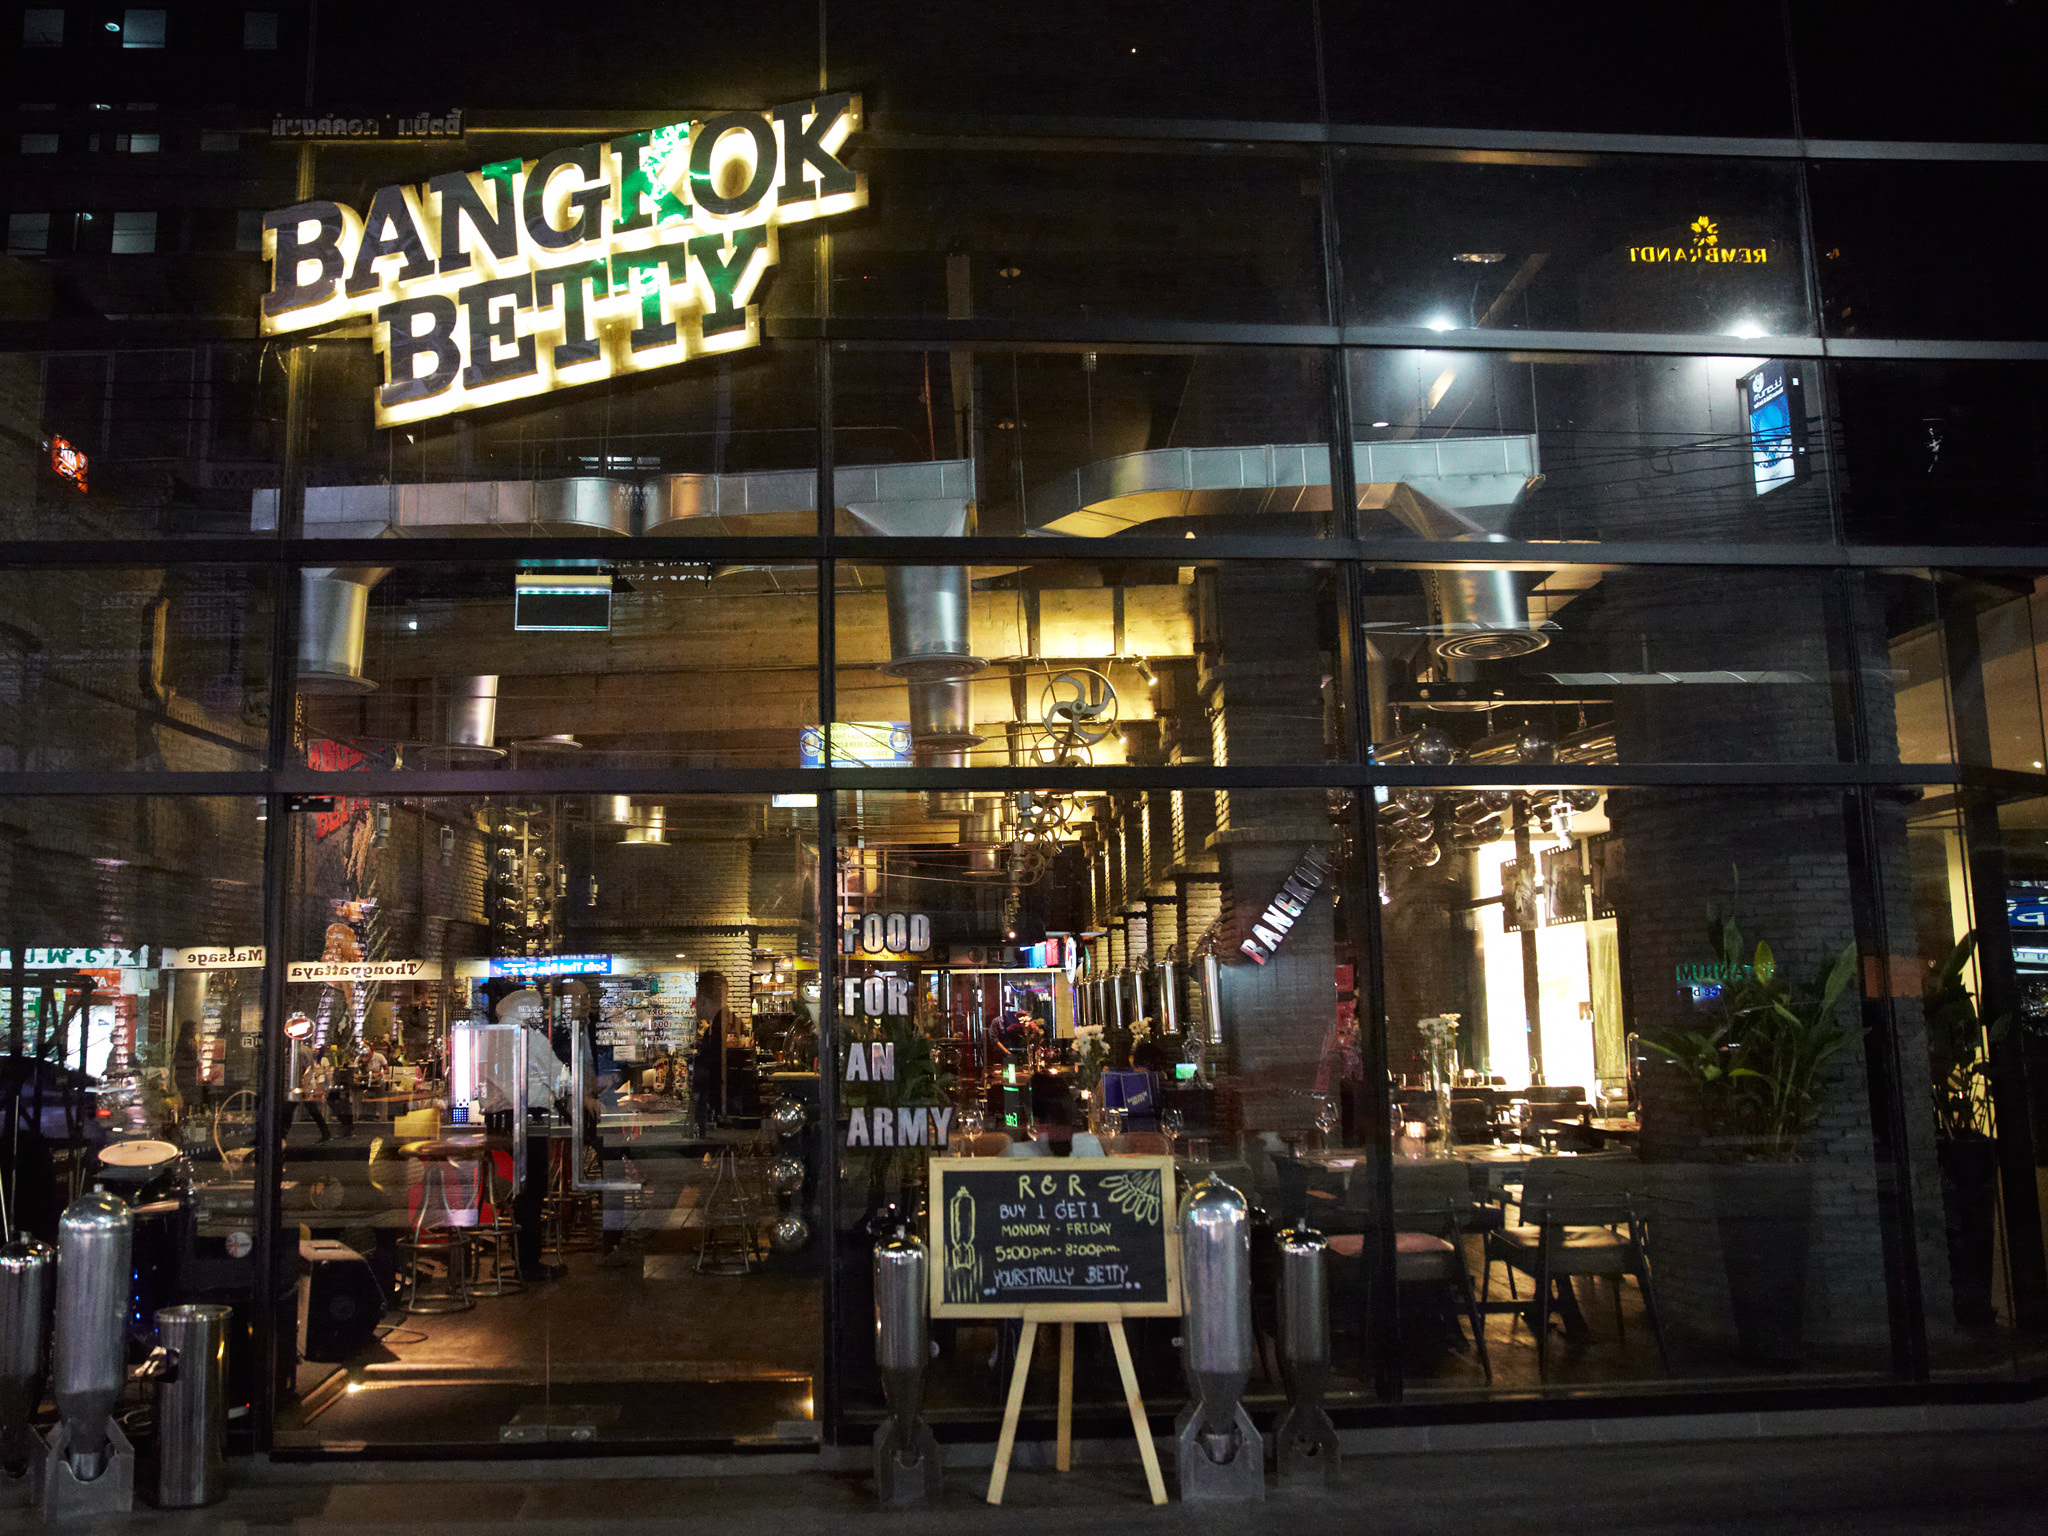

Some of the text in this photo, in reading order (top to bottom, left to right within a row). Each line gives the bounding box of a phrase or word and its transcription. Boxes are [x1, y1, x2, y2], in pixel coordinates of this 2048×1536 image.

[262, 92, 863, 320] BANGKOK
[377, 222, 770, 408] BETTY
[844, 913, 930, 953] FOOD
[844, 976, 909, 1016] FOR
[846, 1042, 894, 1081] AN
[846, 1107, 953, 1147] ARMY
[1018, 1173, 1086, 1200] R & R
[999, 1199, 1101, 1220] BUY 1 GET 1
[1001, 1223, 1051, 1237] MONDAY
[1066, 1222, 1112, 1236] FRIDAY
